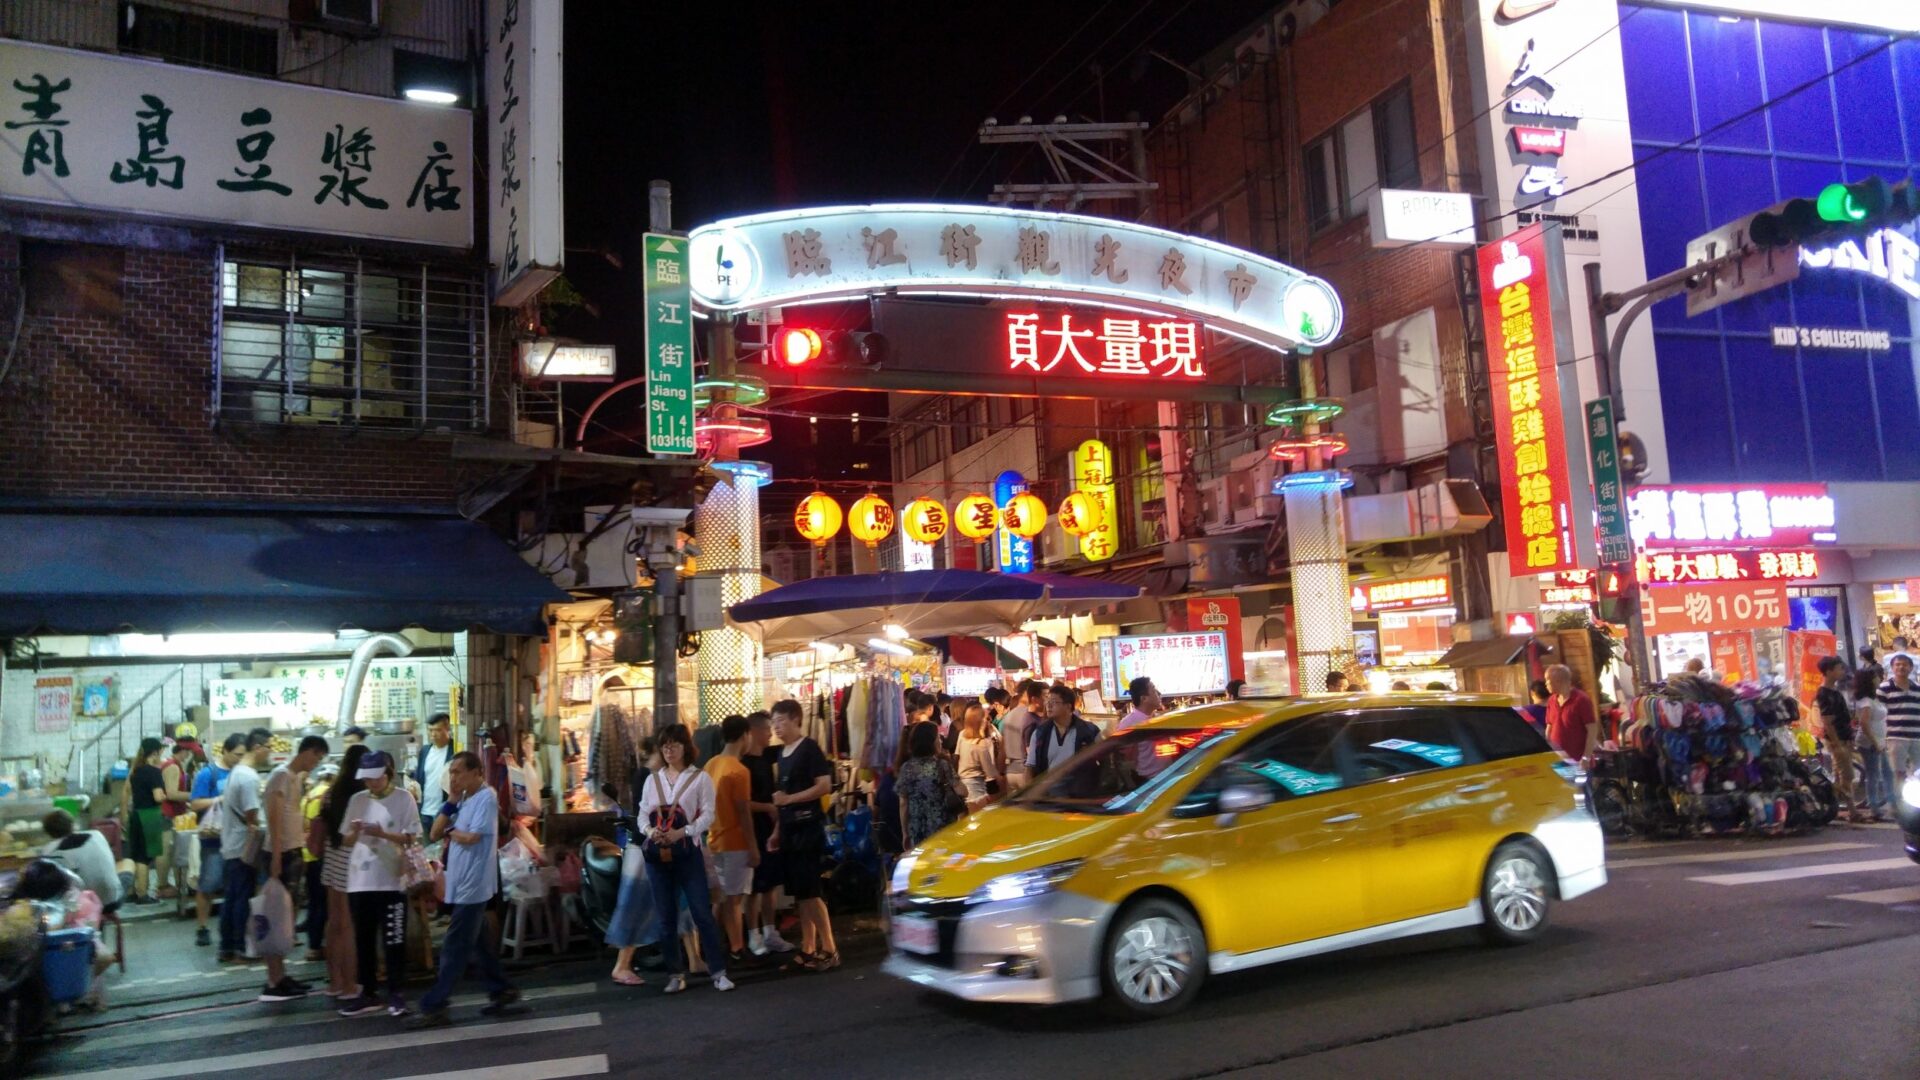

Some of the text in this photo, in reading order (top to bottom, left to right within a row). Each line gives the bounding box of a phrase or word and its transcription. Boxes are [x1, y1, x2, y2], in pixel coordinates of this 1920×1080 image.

[4, 73, 461, 212] 青島豆漿店
[782, 222, 1258, 313] 臨江街觀光夜市
[656, 259, 684, 368] 臨江街
[1811, 328, 1890, 350] COLLECTIONS
[651, 370, 671, 383] Lin
[651, 385, 687, 399] Jiang
[651, 400, 669, 412] St.
[651, 435, 693, 448] 103 116
[1592, 417, 1615, 501] 通化街
[871, 505, 893, 533] 照
[971, 503, 995, 530] 星
[1597, 503, 1617, 513] Tong
[1599, 515, 1615, 524] Hua
[922, 506, 947, 536] 高
